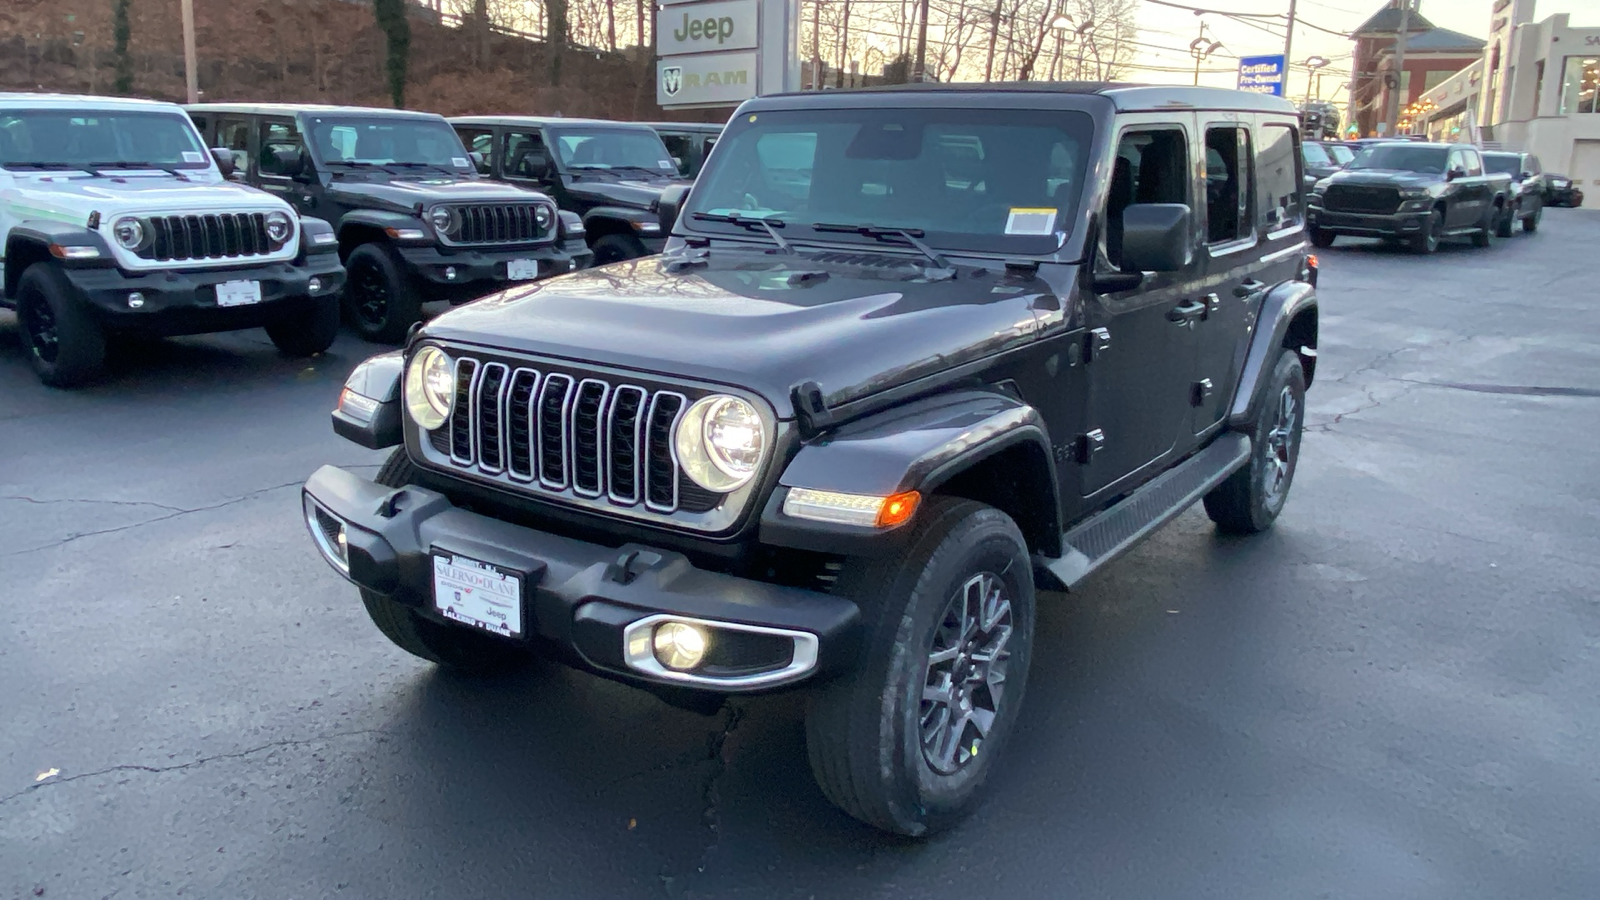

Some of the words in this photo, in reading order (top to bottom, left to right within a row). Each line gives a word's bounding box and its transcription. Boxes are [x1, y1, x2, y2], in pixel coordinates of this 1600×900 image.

[674, 13, 734, 44] Jeep
[1241, 63, 1277, 74] Certified
[685, 70, 747, 87] RAM
[1240, 73, 1281, 84] Pre-Owned
[486, 606, 507, 621] Jeep
